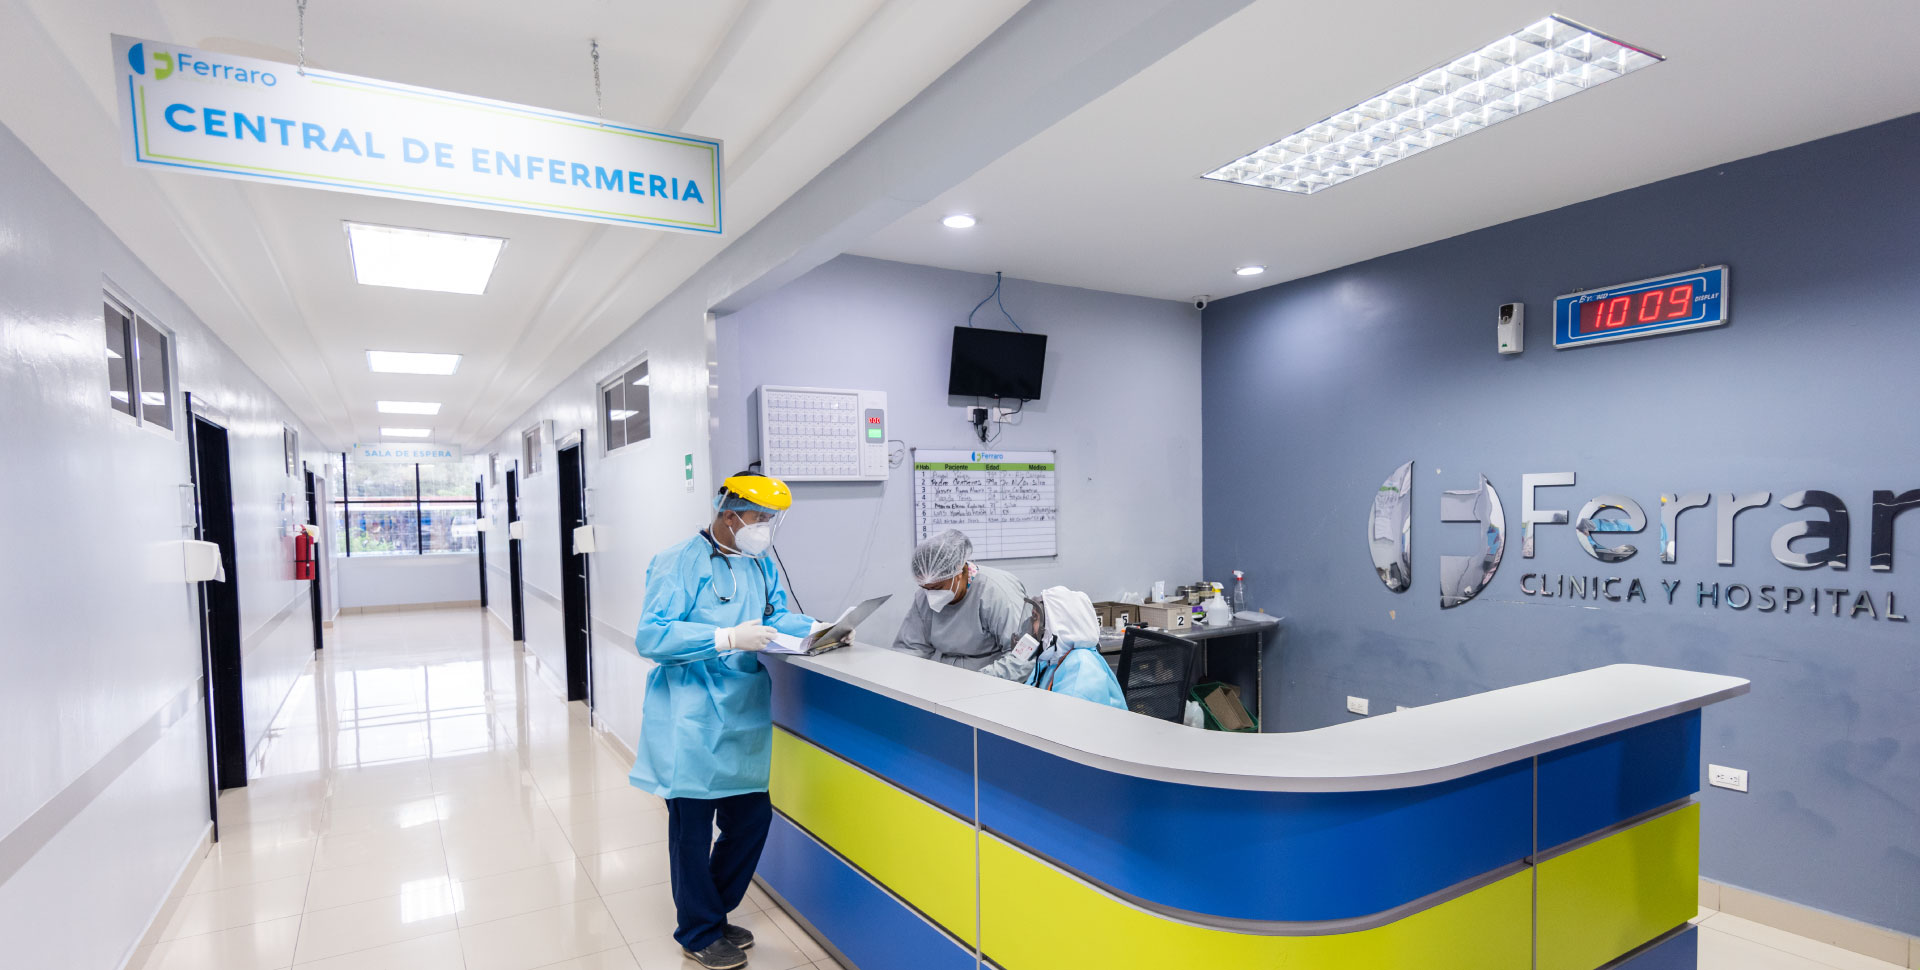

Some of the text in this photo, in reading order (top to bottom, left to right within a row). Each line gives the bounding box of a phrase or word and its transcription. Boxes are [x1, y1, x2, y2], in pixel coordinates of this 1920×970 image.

[177, 53, 277, 87] Ferraro
[164, 103, 705, 204] CENTRAL DE ENFERMERIA
[1694, 292, 1719, 302] DISPLAY
[1519, 573, 1907, 622] CLINICA Y HOSPITAL
[1097, 617, 1101, 626] 3
[1122, 615, 1127, 626] 5
[1178, 616, 1184, 626] 2
